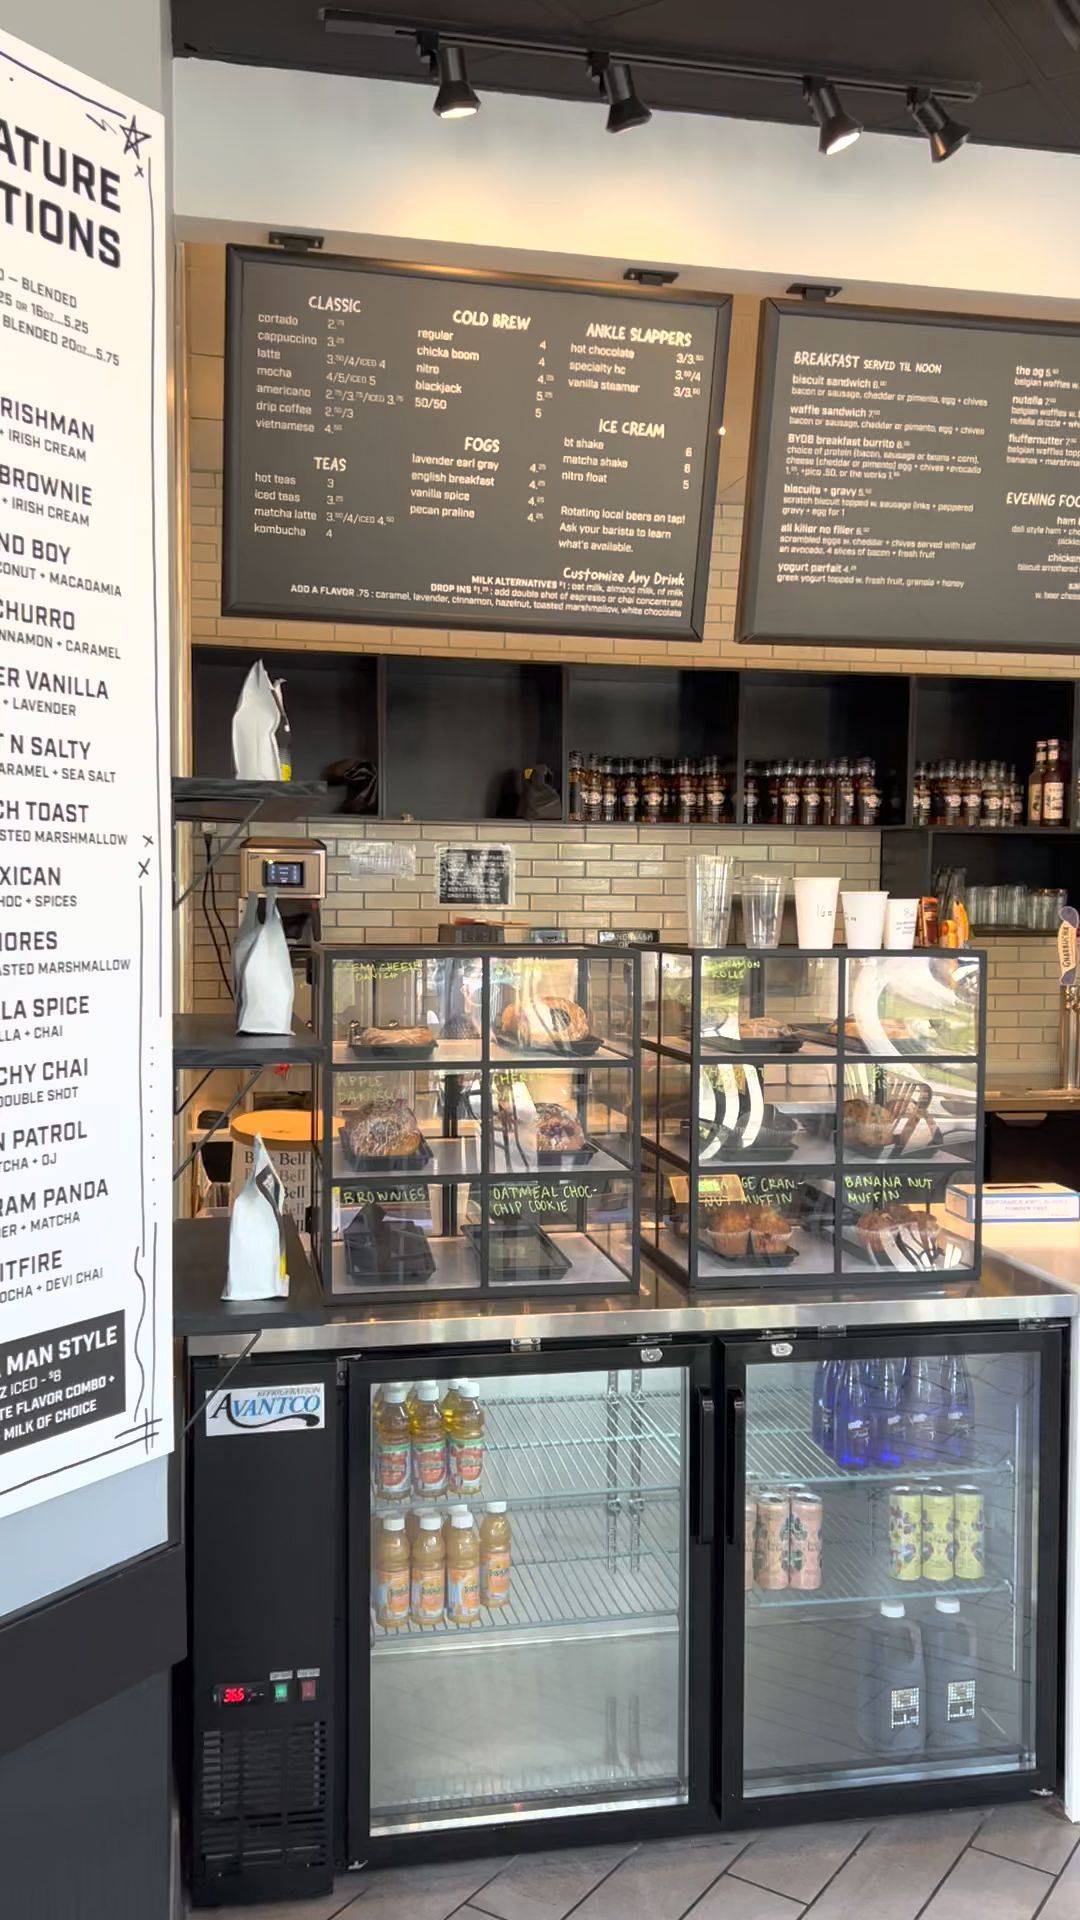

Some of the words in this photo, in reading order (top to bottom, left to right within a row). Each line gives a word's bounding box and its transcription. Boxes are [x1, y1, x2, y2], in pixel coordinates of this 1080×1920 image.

[22, 277, 77, 308] BLENDED
[308, 296, 361, 313] CLASSIC
[258, 313, 299, 326] cortado
[453, 310, 489, 326] COLD
[492, 313, 531, 330] BREW
[2, 314, 58, 344] BLENDED
[418, 329, 454, 341] regular
[586, 322, 626, 340] ANKLE
[630, 327, 693, 347] SLAPPERS
[258, 331, 318, 346] cappuccino
[257, 348, 281, 359] latte
[451, 348, 480, 361] boom
[570, 343, 587, 353] hot
[588, 345, 635, 359] chocolate
[416, 363, 440, 374] nitro
[569, 361, 612, 375] specialty
[793, 350, 860, 369] BREAKFAST
[863, 359, 896, 371] SERVED
[915, 362, 942, 374] NOON
[257, 367, 292, 378] mocha
[415, 380, 462, 394] blackjack
[568, 378, 599, 390] vanilla
[600, 381, 641, 393] steamer
[792, 375, 825, 386] biscuit
[826, 378, 871, 389] sandwich
[256, 384, 311, 398] americano
[256, 401, 277, 414] drip
[279, 404, 312, 415] coffee
[415, 397, 447, 409] 50/50
[790, 405, 820, 416] waffle
[822, 407, 867, 418] sandwich
[1, 397, 94, 442] RISHMAN
[256, 418, 315, 433] vietnamese
[599, 418, 618, 433] ICE
[621, 421, 665, 439] CREAM
[8, 429, 41, 448] IRISH
[44, 439, 87, 462] CREAM
[464, 437, 500, 453] FOGS
[576, 438, 604, 450] shake
[816, 436, 861, 447] breakfast
[863, 438, 895, 449] burrito
[313, 457, 347, 472] TEAS
[412, 453, 454, 466] lavender
[456, 458, 475, 468] earl
[562, 454, 598, 466] matcha
[600, 458, 629, 469] shake
[255, 472, 272, 483] hot
[274, 475, 297, 485] teas
[411, 471, 446, 482] english
[448, 473, 495, 486] breakfast
[562, 471, 584, 482] nitro
[586, 472, 607, 483] float
[0, 464, 92, 506] BROWNIE
[830, 486, 857, 497] gravy
[255, 489, 276, 500] iced
[279, 492, 300, 502] teas
[410, 488, 441, 499] vanilla
[444, 491, 470, 501] spice
[1006, 492, 1056, 506] EVENING
[12, 497, 44, 516] IRISH
[48, 506, 89, 526] CREAM
[254, 506, 292, 519] matcha
[294, 510, 317, 521] latte
[410, 505, 440, 515] pecan
[442, 507, 475, 518] praline
[561, 505, 600, 520] Rotating
[602, 507, 624, 520] local
[626, 511, 652, 522] beers
[254, 523, 306, 537] kombucha
[560, 522, 577, 532] Ask
[580, 525, 600, 535] your
[602, 526, 635, 537] barista
[648, 529, 672, 540] learn
[32, 539, 71, 565] BOY
[778, 561, 809, 573] yogurt
[811, 562, 842, 573] parfait
[50, 572, 122, 597] MACADAMIA
[471, 575, 494, 585] MILK
[494, 577, 558, 589] ALTERNATIVES
[563, 567, 625, 584] Customize
[628, 570, 651, 588] Any
[654, 572, 685, 586] Drink
[66, 640, 121, 659] CARAMEL
[26, 670, 109, 699] VANILLA
[13, 697, 76, 716] LAVENDER
[11, 734, 24, 754] N
[31, 737, 91, 760] SALTY
[62, 768, 85, 781] SEA
[88, 770, 116, 783] SALT
[26, 802, 89, 823] TOAST
[35, 831, 128, 846] MARSHMALLOW
[35, 895, 77, 908] SPICES
[0, 930, 58, 951] ORES
[38, 959, 131, 975] MARSHMALLOW
[33, 996, 89, 1018] SPICE
[34, 1025, 63, 1039] CHAI
[42, 1058, 88, 1081] CHAI
[47, 1086, 79, 1102] SHOT
[13, 1121, 88, 1149] PATROL
[41, 1153, 57, 1166] OJ
[844, 1176, 902, 1189] BANANA
[907, 1177, 933, 1188] NUT
[43, 1178, 109, 1209] PANDA
[343, 1186, 426, 1205] BROWNIES
[493, 1186, 558, 1201] OATMEAL
[848, 1190, 900, 1204] MUFFIN
[493, 1201, 523, 1216] CHIP
[528, 1200, 569, 1215] COOKIE
[30, 1211, 80, 1232] MATCHA
[45, 1275, 73, 1293] DEVI
[76, 1267, 104, 1285] CHAI
[6, 1344, 53, 1376] MAN
[59, 1325, 118, 1360] STYLE
[11, 1377, 38, 1395] ICED
[15, 1391, 63, 1415] FLAVOR
[65, 1375, 107, 1399] COMBO
[209, 1391, 321, 1428] AVANTCO
[3, 1418, 35, 1441] MILK
[36, 1412, 52, 1429] OF
[55, 1398, 98, 1421] CHOICE
